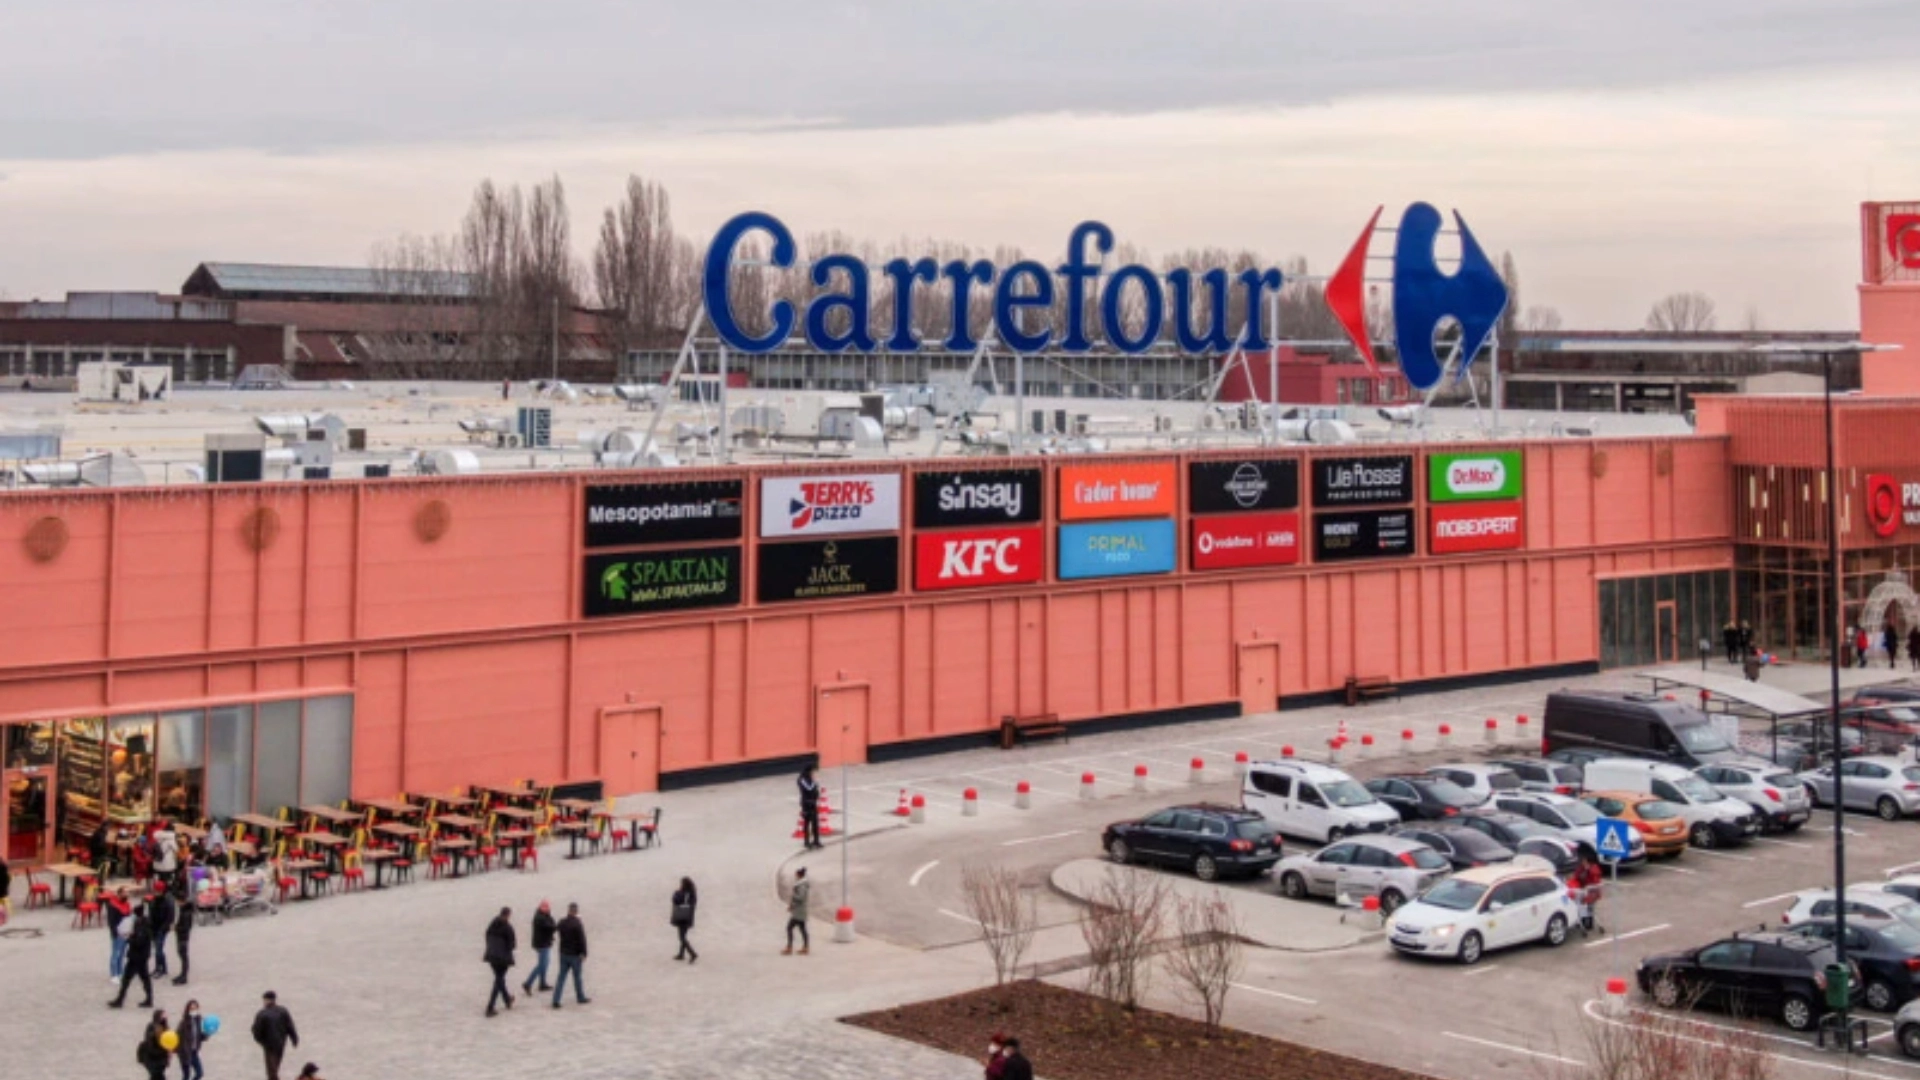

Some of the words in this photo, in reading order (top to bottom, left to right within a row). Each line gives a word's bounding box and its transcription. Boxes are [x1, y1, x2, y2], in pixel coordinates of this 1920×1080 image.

[702, 211, 1283, 353] Carrefour
[939, 476, 1022, 516] sinsay
[589, 502, 712, 525] Mesopotamia
[812, 505, 862, 523] pizza
[939, 537, 1021, 578] KFC
[632, 558, 729, 585] SPARTAN
[808, 565, 851, 584] JACK
